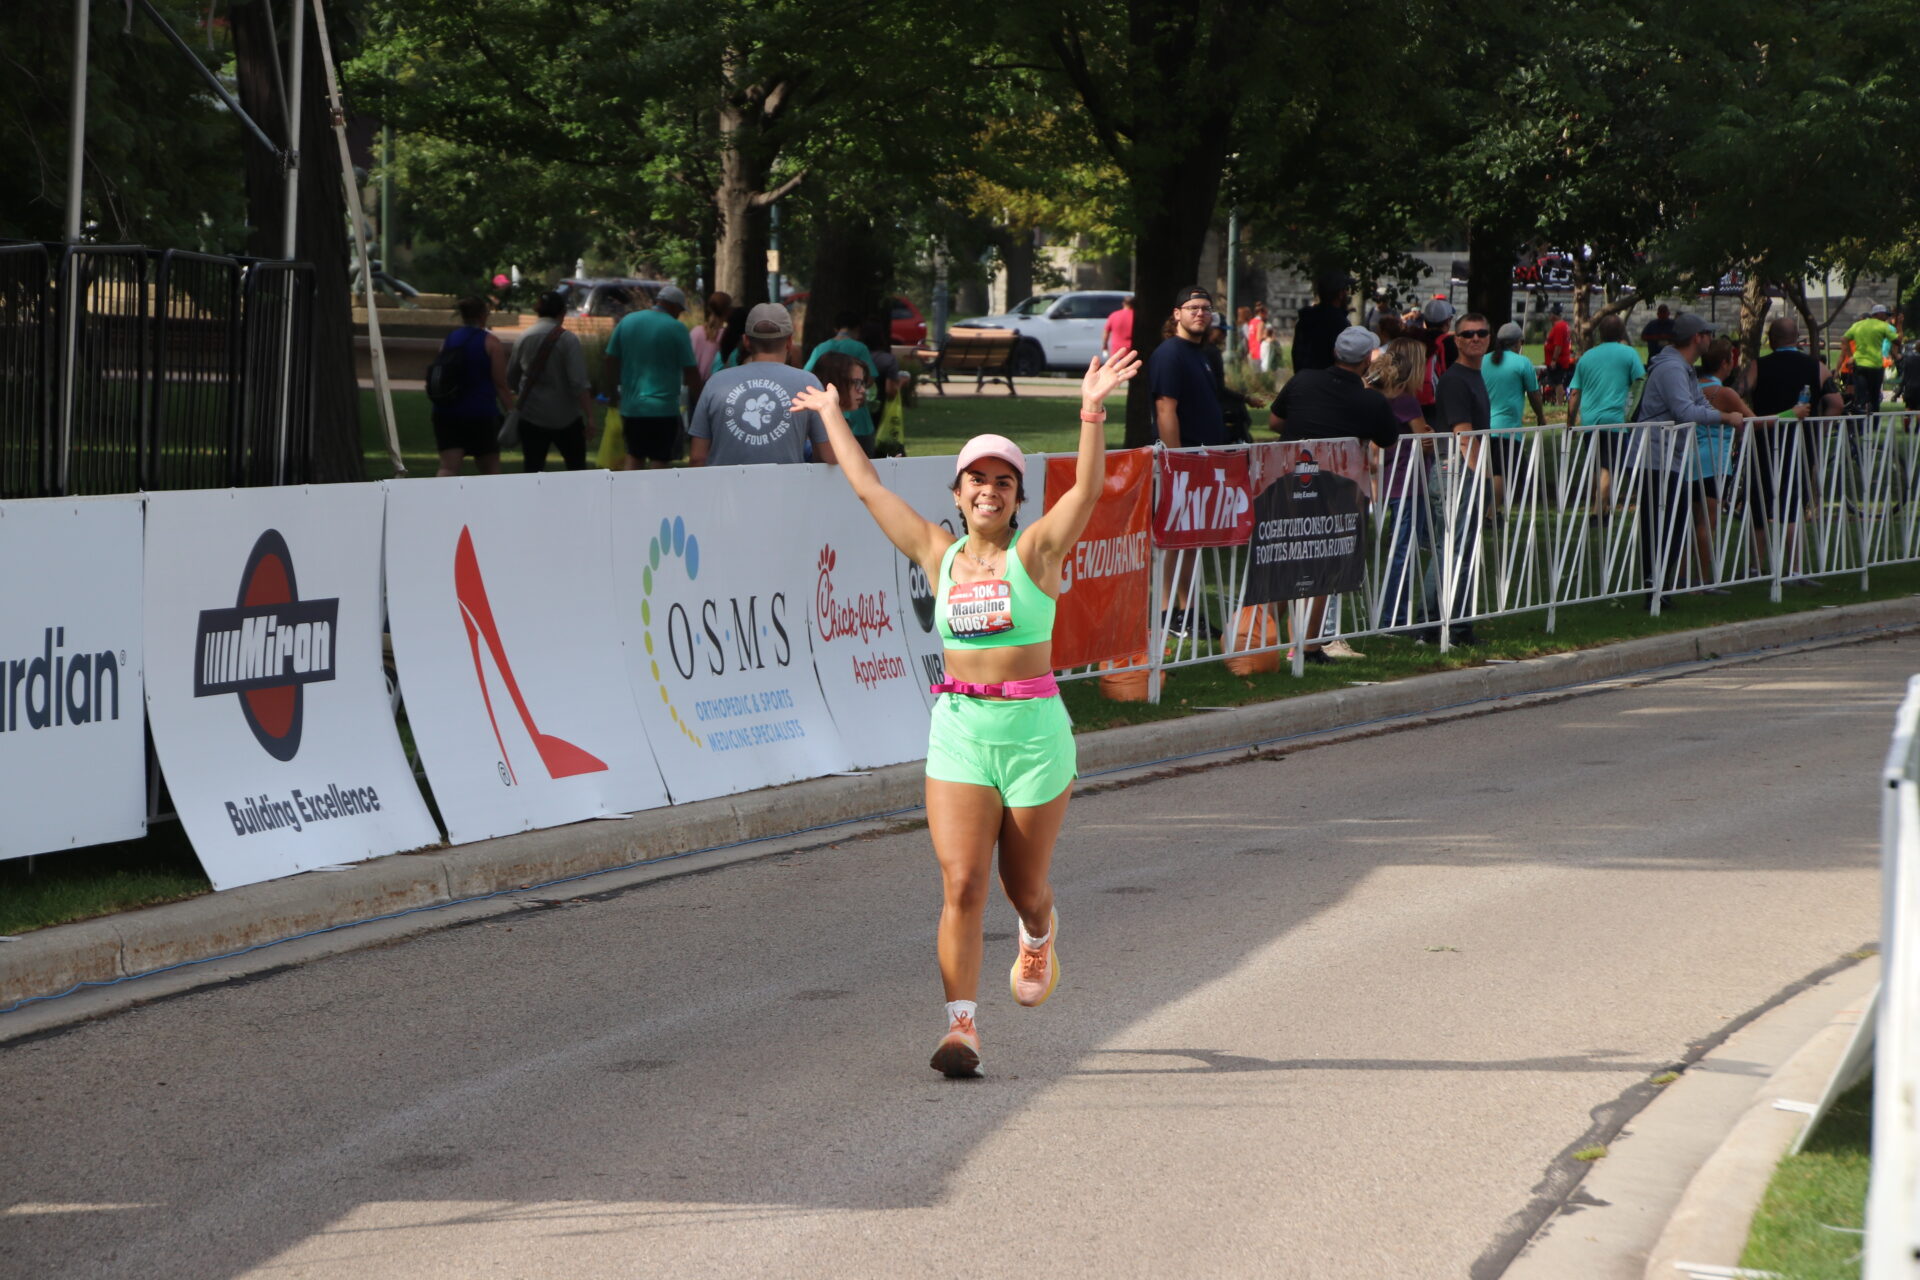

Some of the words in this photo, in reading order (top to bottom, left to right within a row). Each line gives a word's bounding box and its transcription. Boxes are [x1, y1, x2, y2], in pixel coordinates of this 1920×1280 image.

[725, 383, 747, 405] SOME
[746, 379, 792, 407] THERAPISTS
[725, 419, 746, 440] HAVE
[744, 434, 769, 446] FOUR
[769, 420, 790, 441] LEGS
[1076, 531, 1147, 580] ENDURANCE
[909, 564, 933, 598] ab
[972, 584, 995, 599] 10K
[949, 615, 990, 632] 10062
[952, 600, 1005, 616] Madeline
[238, 615, 331, 681] Miron
[0, 626, 119, 732] rdian
[852, 651, 907, 691] Appleton
[921, 653, 945, 685] WB
[695, 693, 752, 721] ORTHOPEDIC
[752, 693, 761, 713] &
[759, 688, 794, 712] SPORTS
[707, 725, 753, 752] MEDICINE
[750, 719, 806, 748] SPECIALISTS
[224, 794, 303, 836] Building
[290, 783, 382, 823] Excellence
